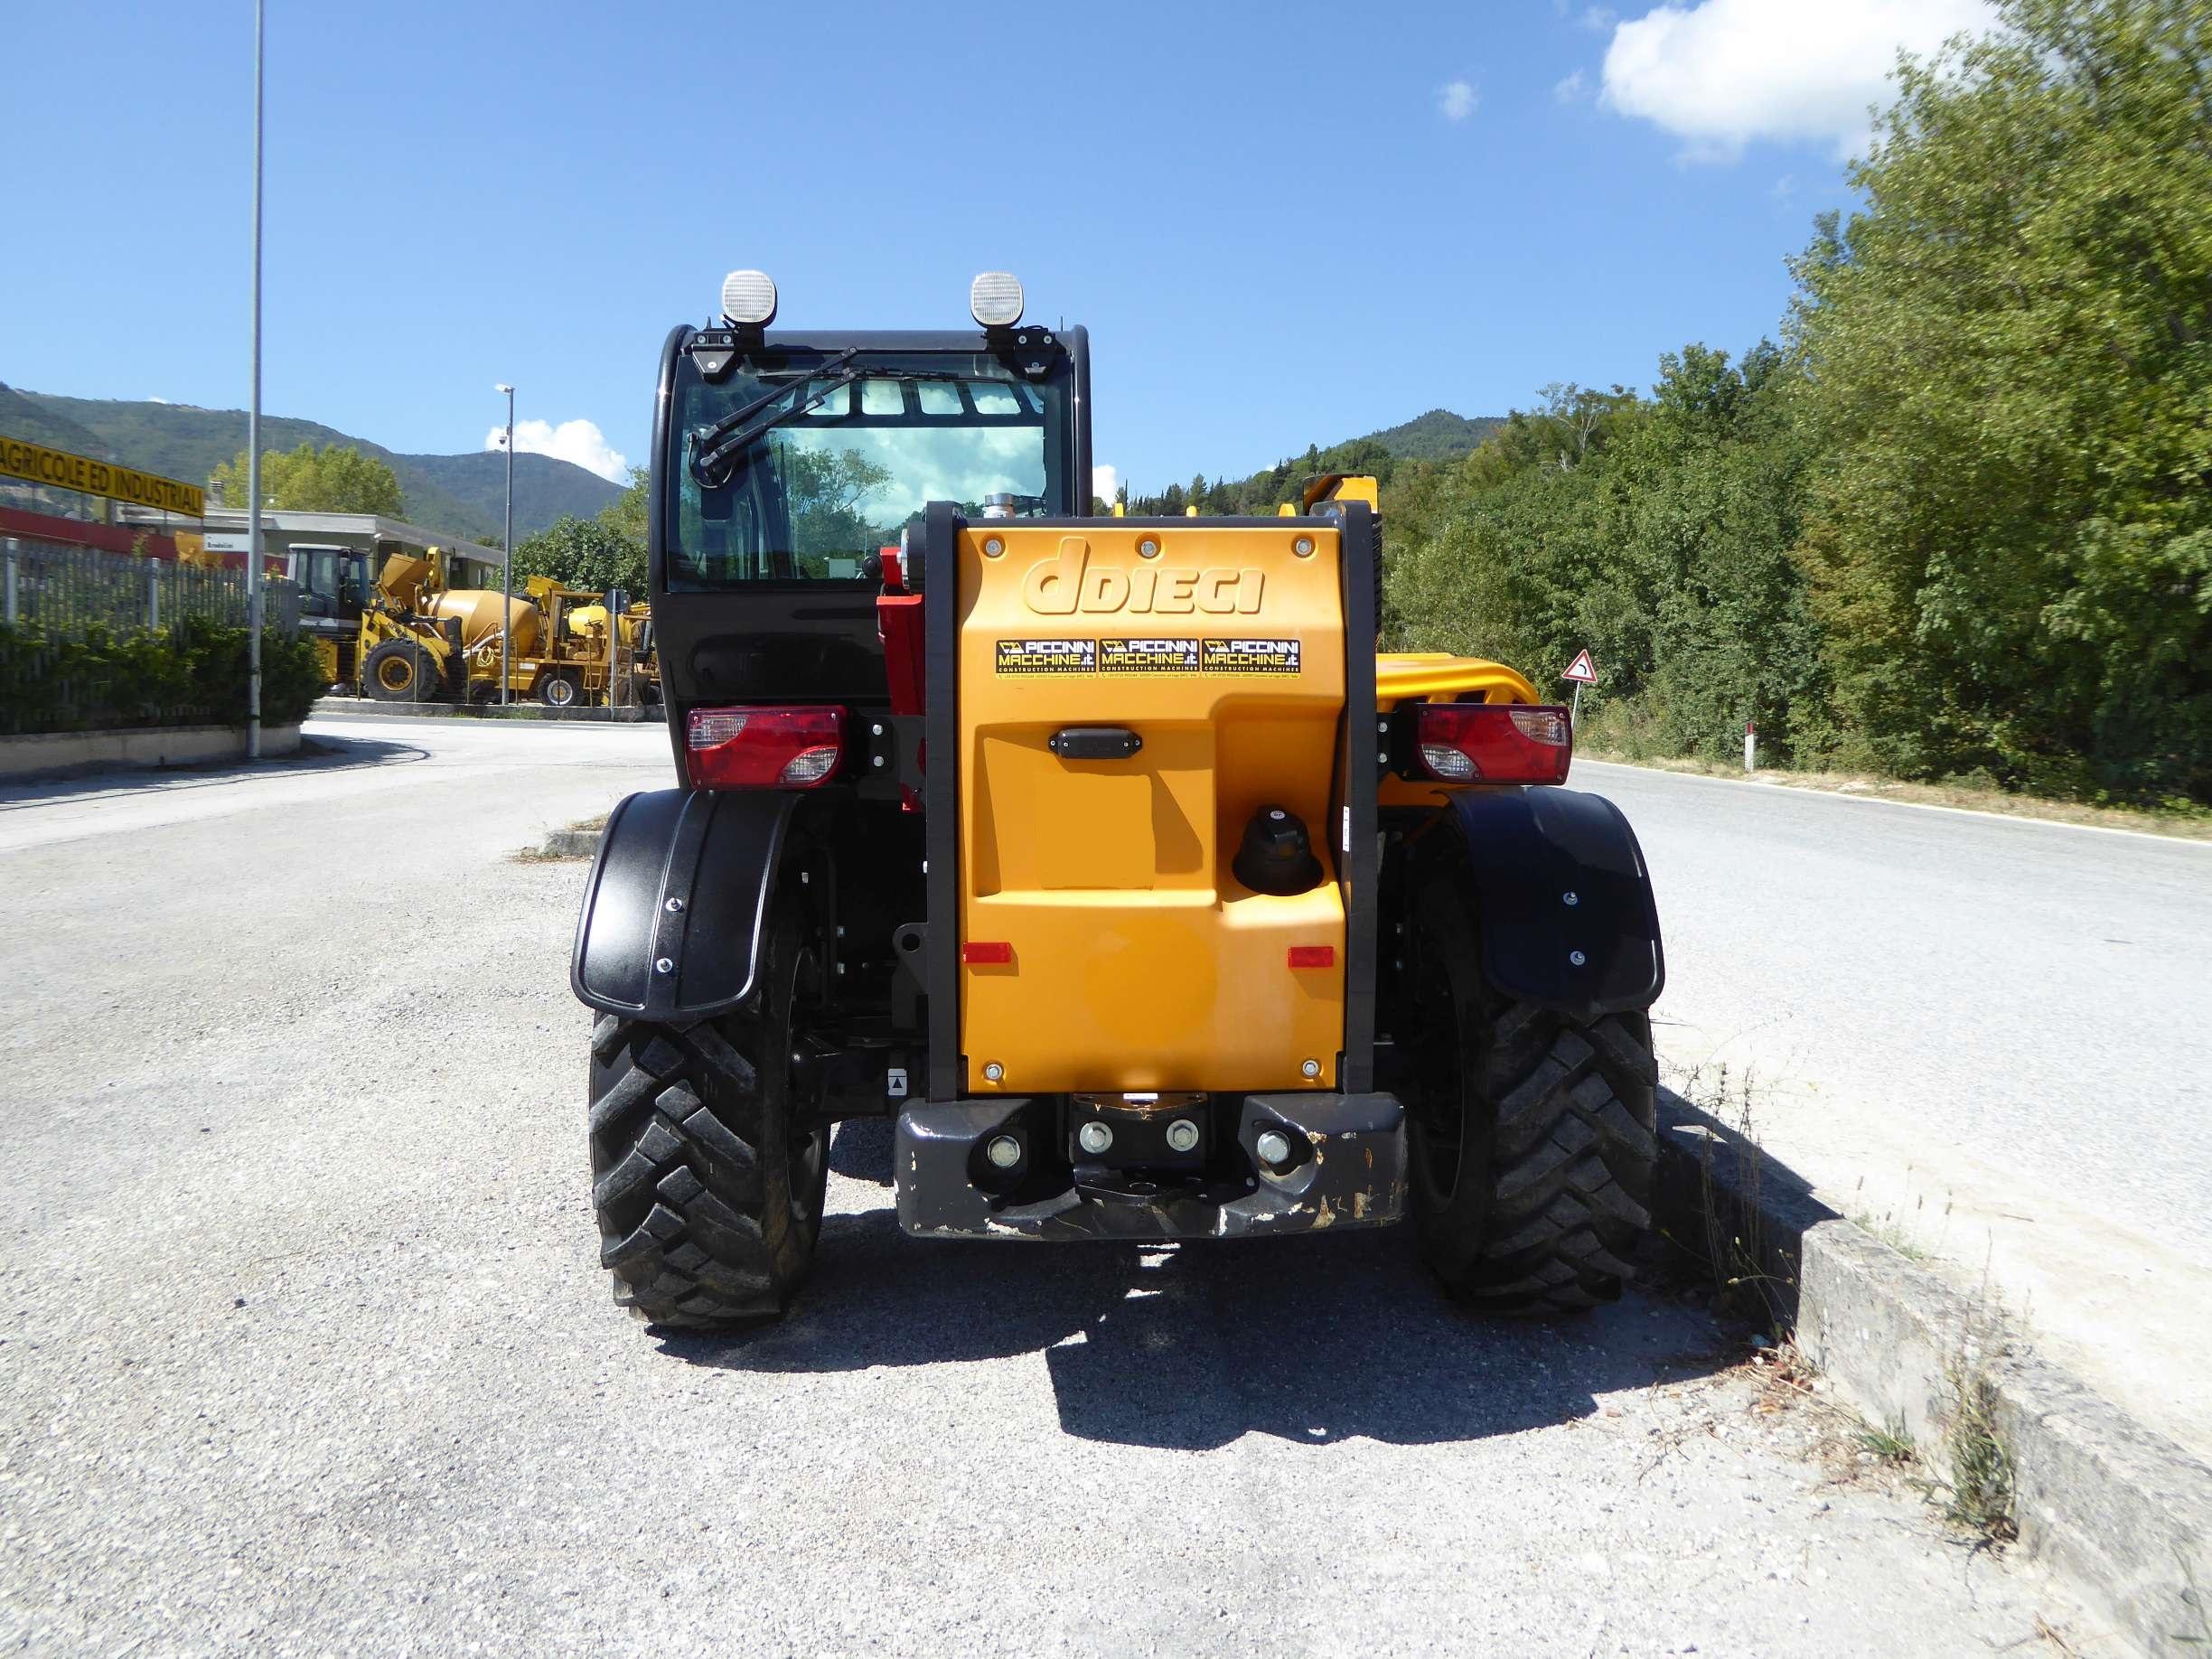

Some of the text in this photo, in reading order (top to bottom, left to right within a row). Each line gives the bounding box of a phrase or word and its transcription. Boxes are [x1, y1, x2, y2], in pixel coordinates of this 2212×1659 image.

[89, 463, 108, 492] ED
[114, 469, 202, 512] INDUSTRIALI
[1026, 642, 1094, 654] PICCININI
[1129, 640, 1197, 653] PICCININI
[1231, 641, 1298, 654] PICCININI
[998, 653, 1094, 666] MACCHINE.it
[1101, 653, 1197, 665] MACCHINE.it
[1204, 653, 1298, 666] MACCHINE.it
